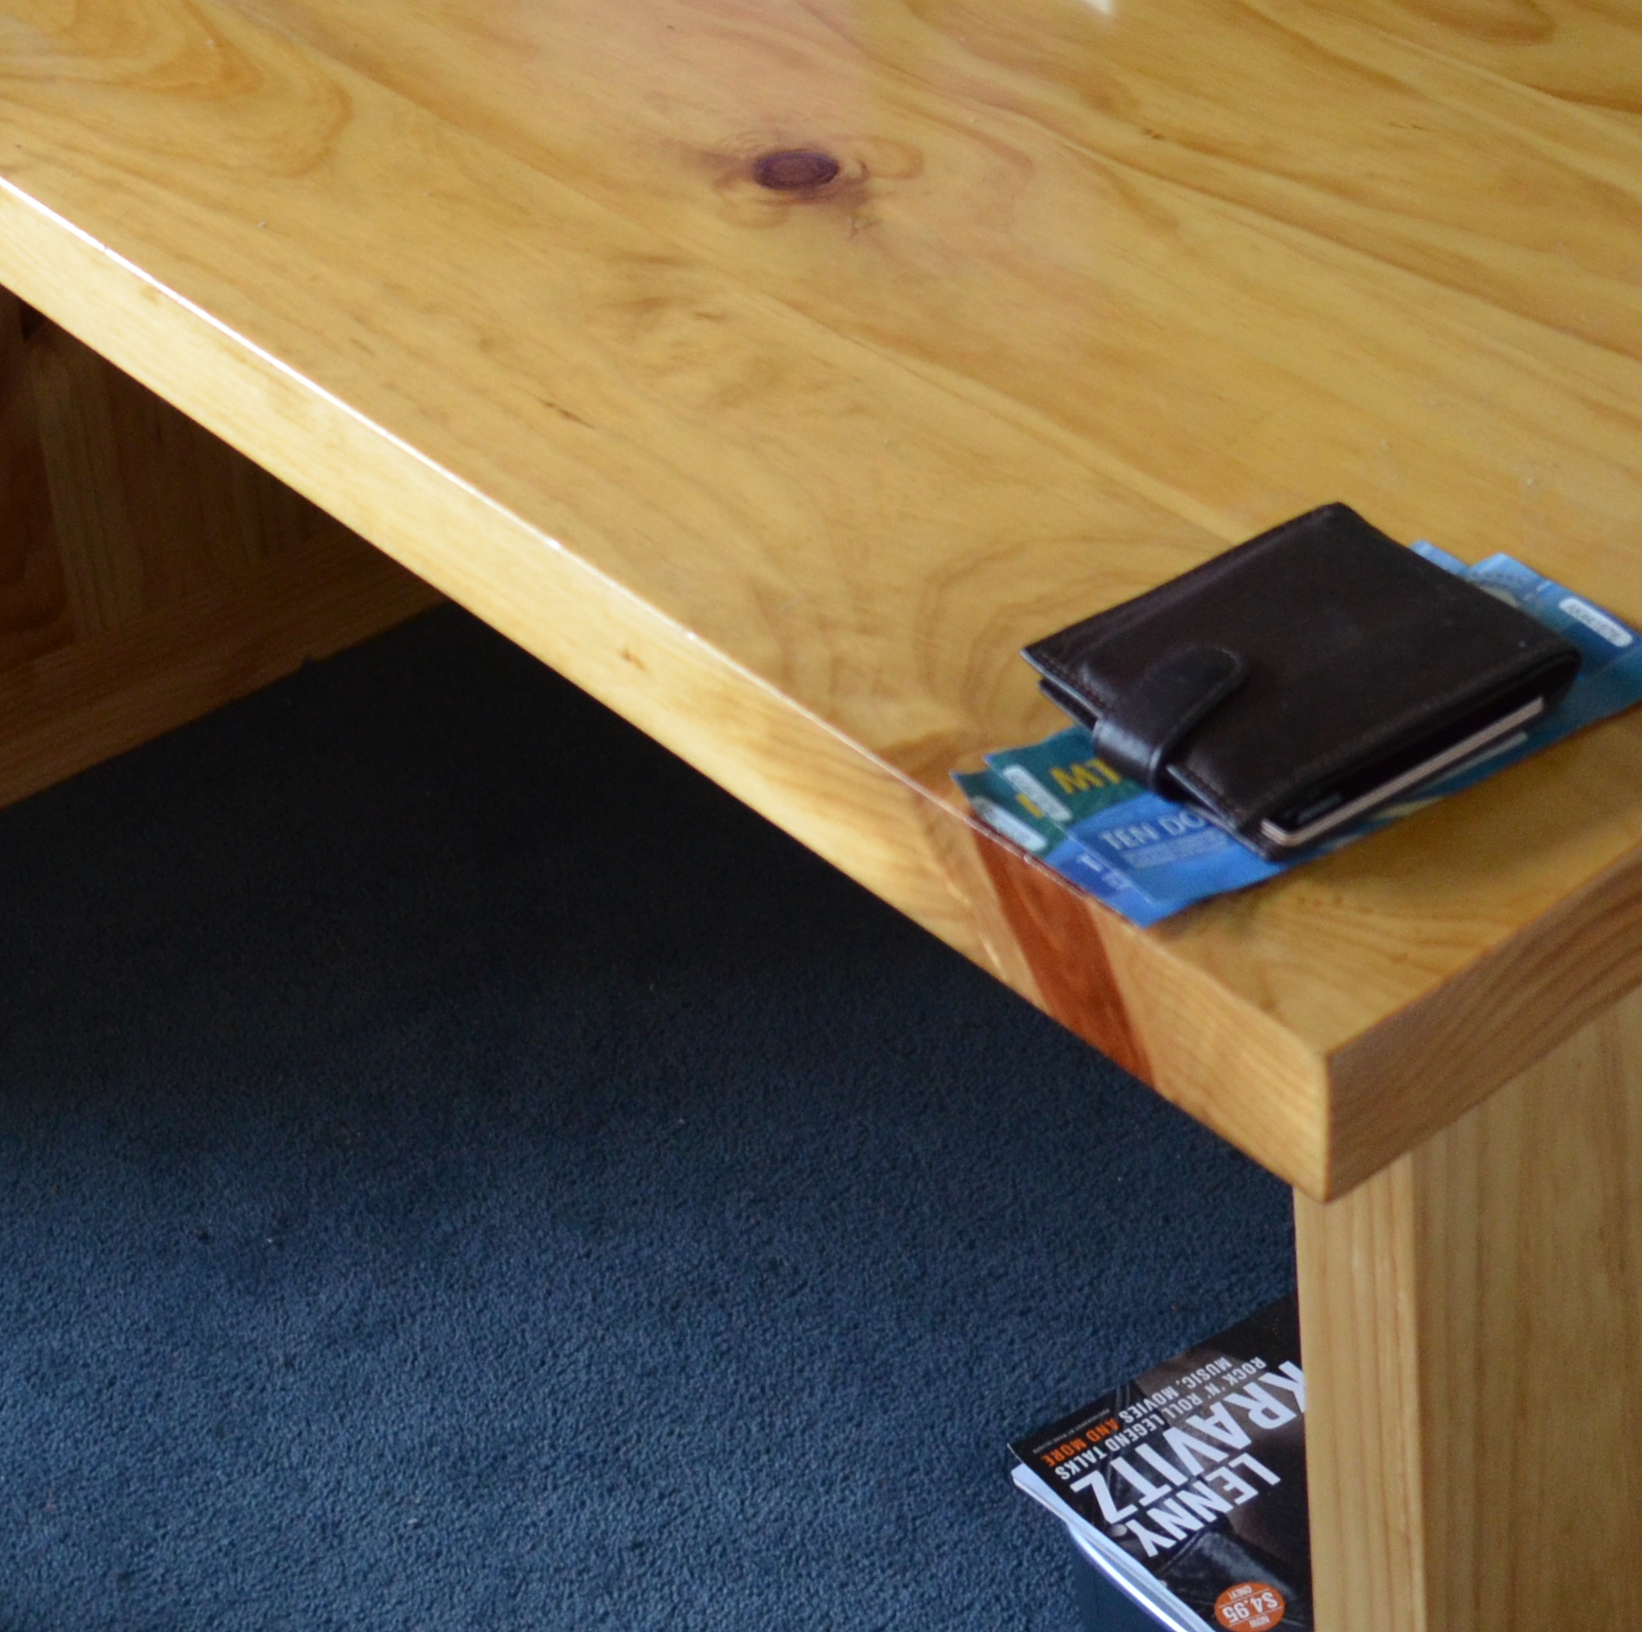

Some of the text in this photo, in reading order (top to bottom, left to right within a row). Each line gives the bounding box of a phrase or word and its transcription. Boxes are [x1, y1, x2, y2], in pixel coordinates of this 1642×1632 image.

[1050, 758, 1122, 795] MT
[1100, 822, 1160, 851] TEN
[1220, 1355, 1267, 1386] ROCK
[1040, 1356, 1233, 1468] MUSIC, MOVIES AND MORE
[1165, 1393, 1203, 1421] ROLL
[1069, 1360, 1306, 1525] KRAVITZ
[1104, 1415, 1166, 1453] LEGEND
[1054, 1447, 1108, 1481] TALKS
[1125, 1452, 1282, 1558] LENNY
[1221, 1591, 1279, 1624] $4.95
[1248, 1613, 1271, 1630] NOW
